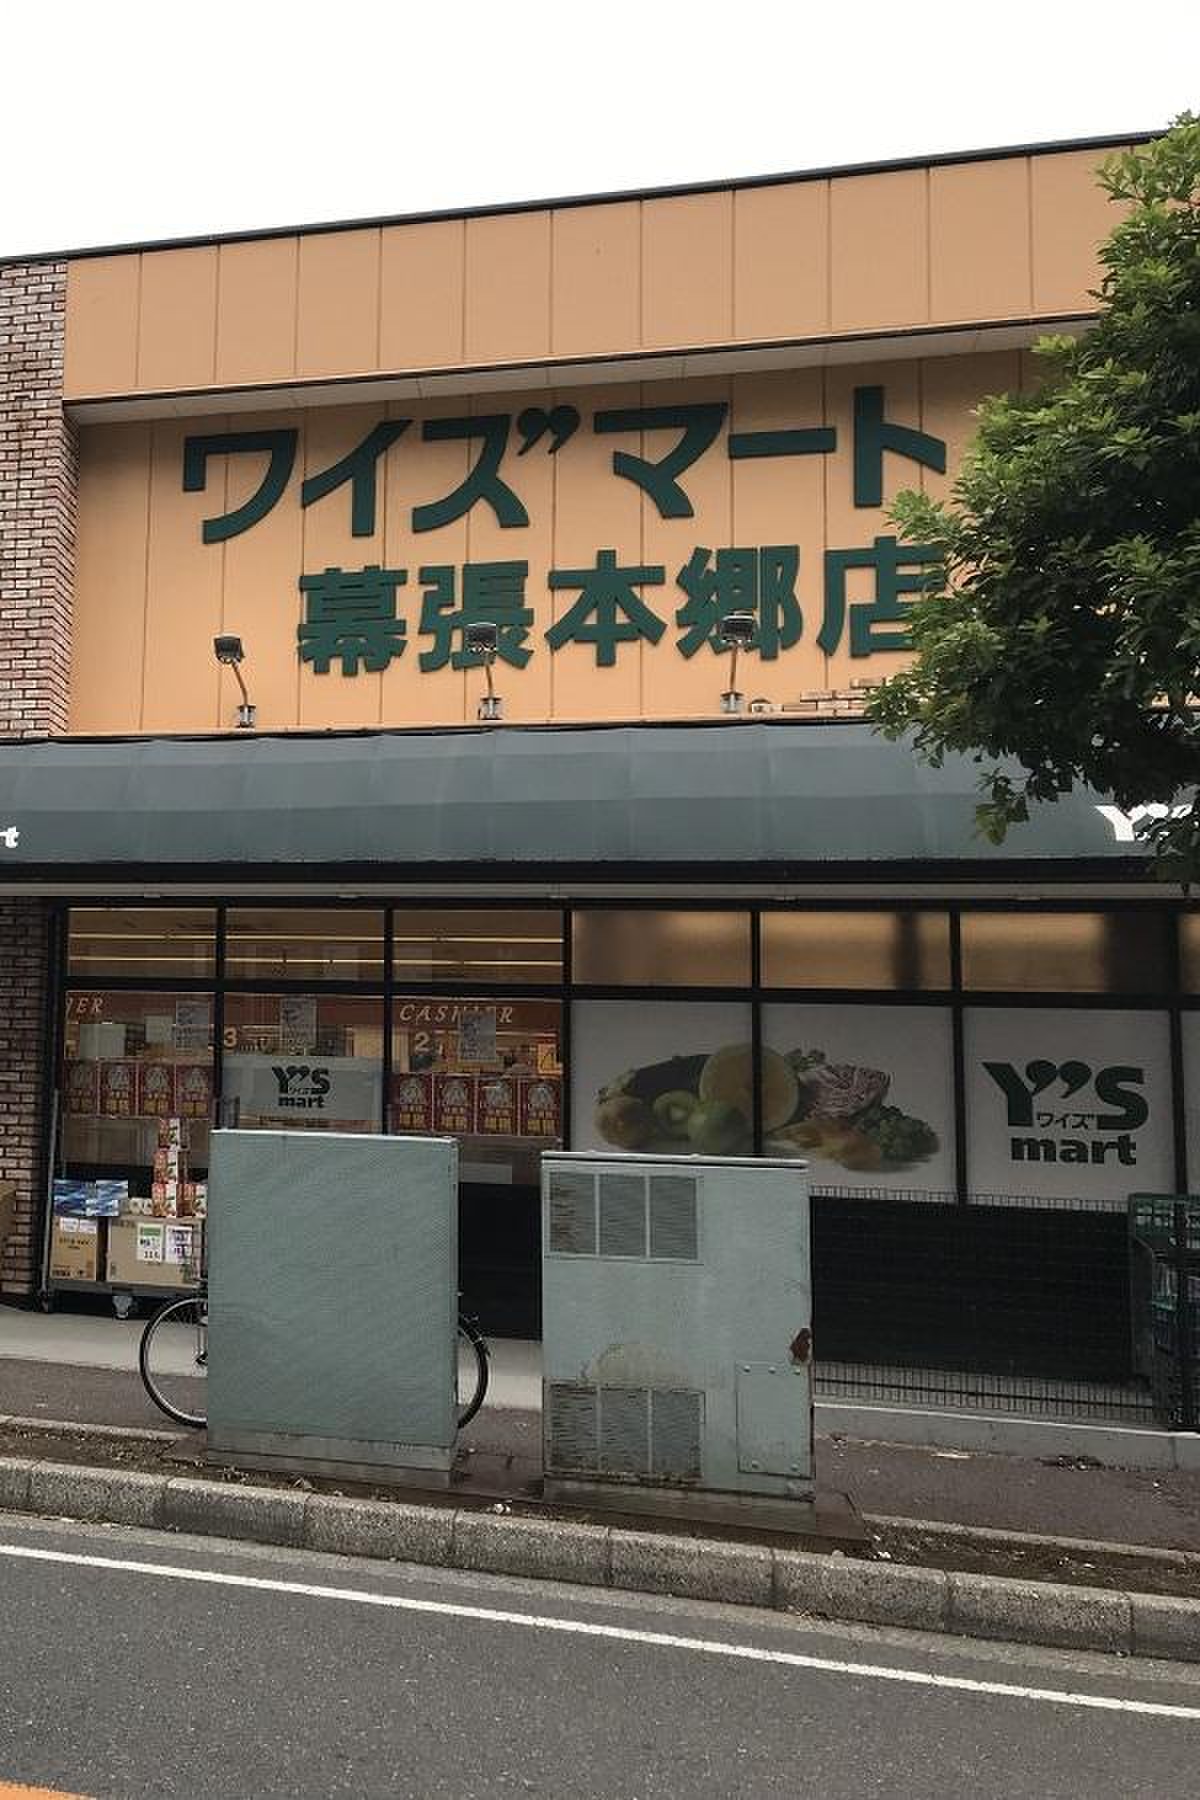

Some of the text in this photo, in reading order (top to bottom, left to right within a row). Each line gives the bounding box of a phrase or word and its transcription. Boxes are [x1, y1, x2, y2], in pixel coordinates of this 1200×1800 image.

[296, 536, 946, 677] 幕張本郷店
[223, 1027, 238, 1048] 3
[413, 1032, 431, 1052] 2
[278, 1095, 325, 1109] mart
[1036, 1112, 1097, 1129] ワイズ
[1010, 1134, 1137, 1166] mart
